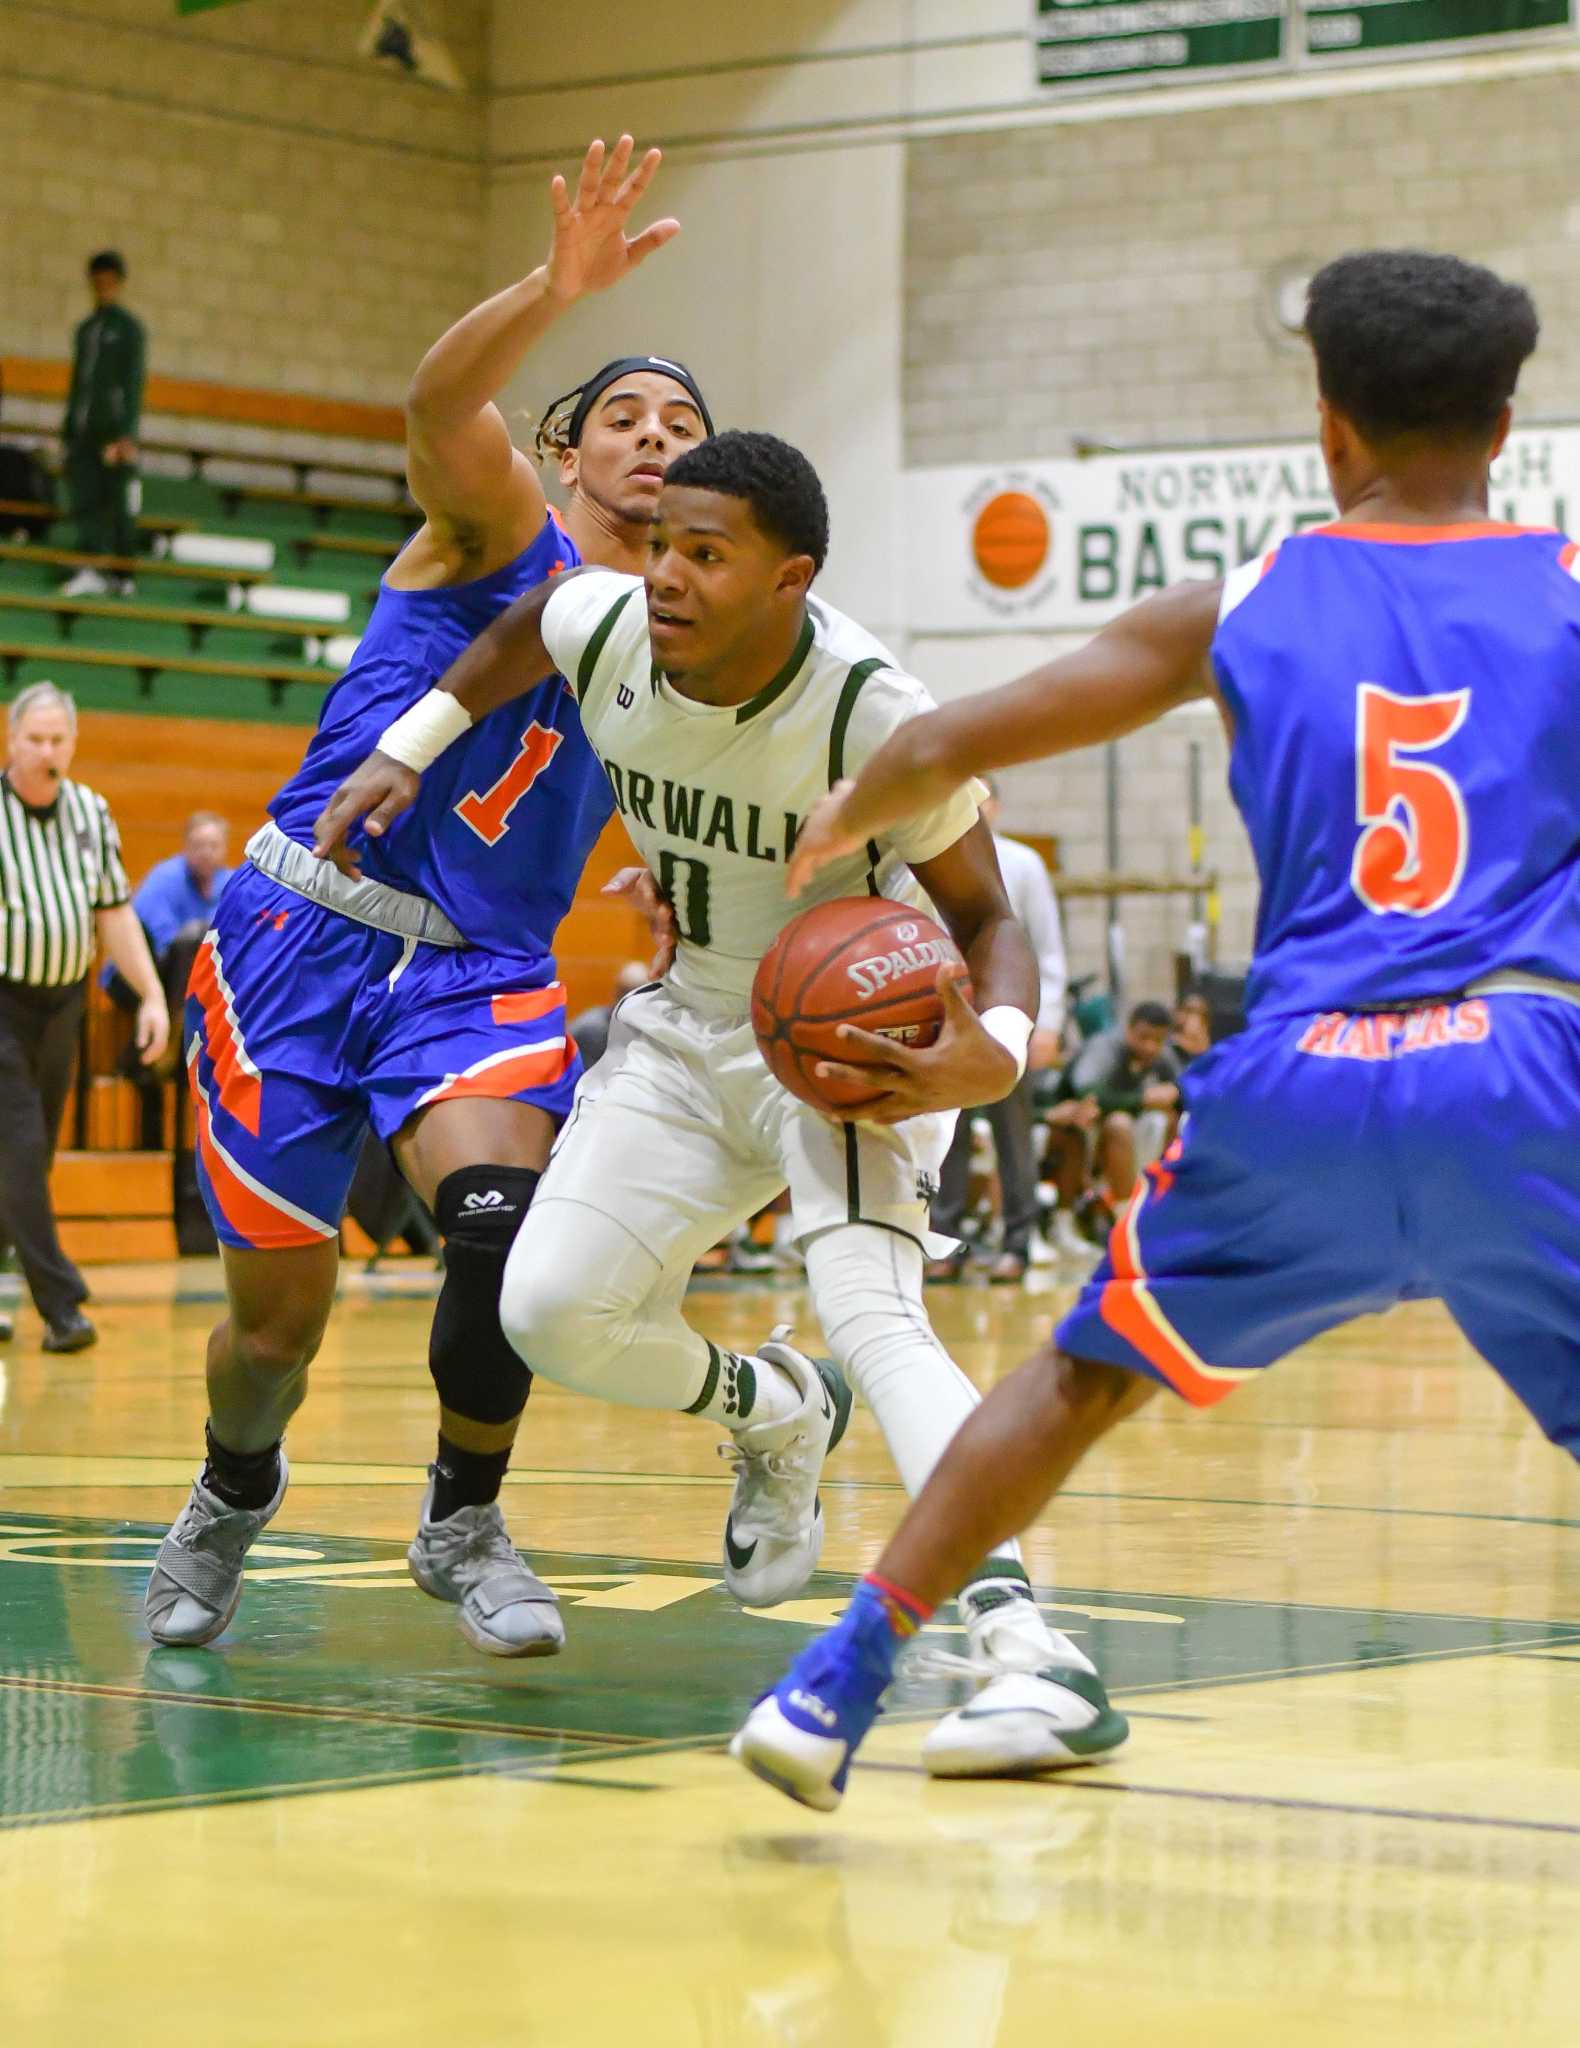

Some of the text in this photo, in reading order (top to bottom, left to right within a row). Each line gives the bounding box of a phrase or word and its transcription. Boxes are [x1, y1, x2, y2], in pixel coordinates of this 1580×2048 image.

[1117, 455, 1330, 512] NORWAL
[453, 719, 565, 847] 1
[1351, 682, 1472, 918] 5
[659, 849, 712, 949] 0
